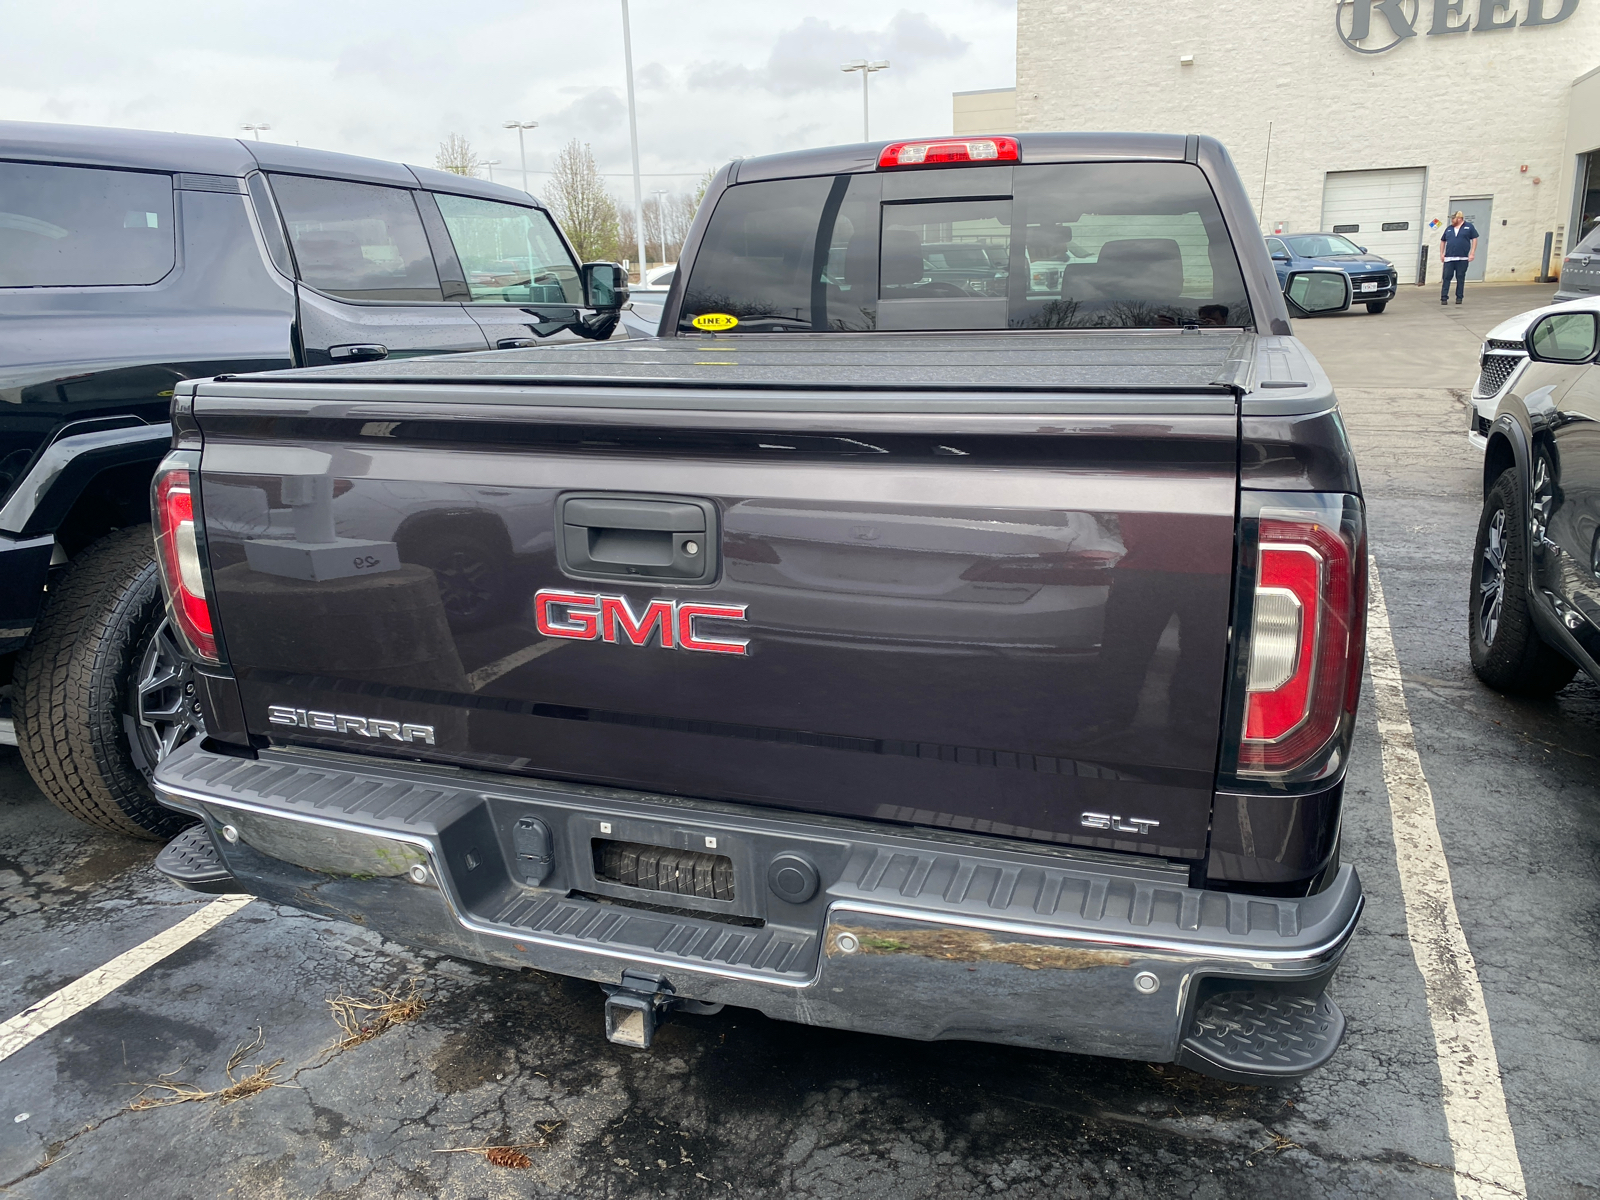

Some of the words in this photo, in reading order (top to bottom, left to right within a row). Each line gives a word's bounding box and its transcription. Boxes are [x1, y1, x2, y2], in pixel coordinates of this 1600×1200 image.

[1346, 0, 1581, 40] REED
[535, 588, 750, 656] GMC
[267, 705, 436, 746] SIERRA
[1081, 812, 1160, 835] SLT
